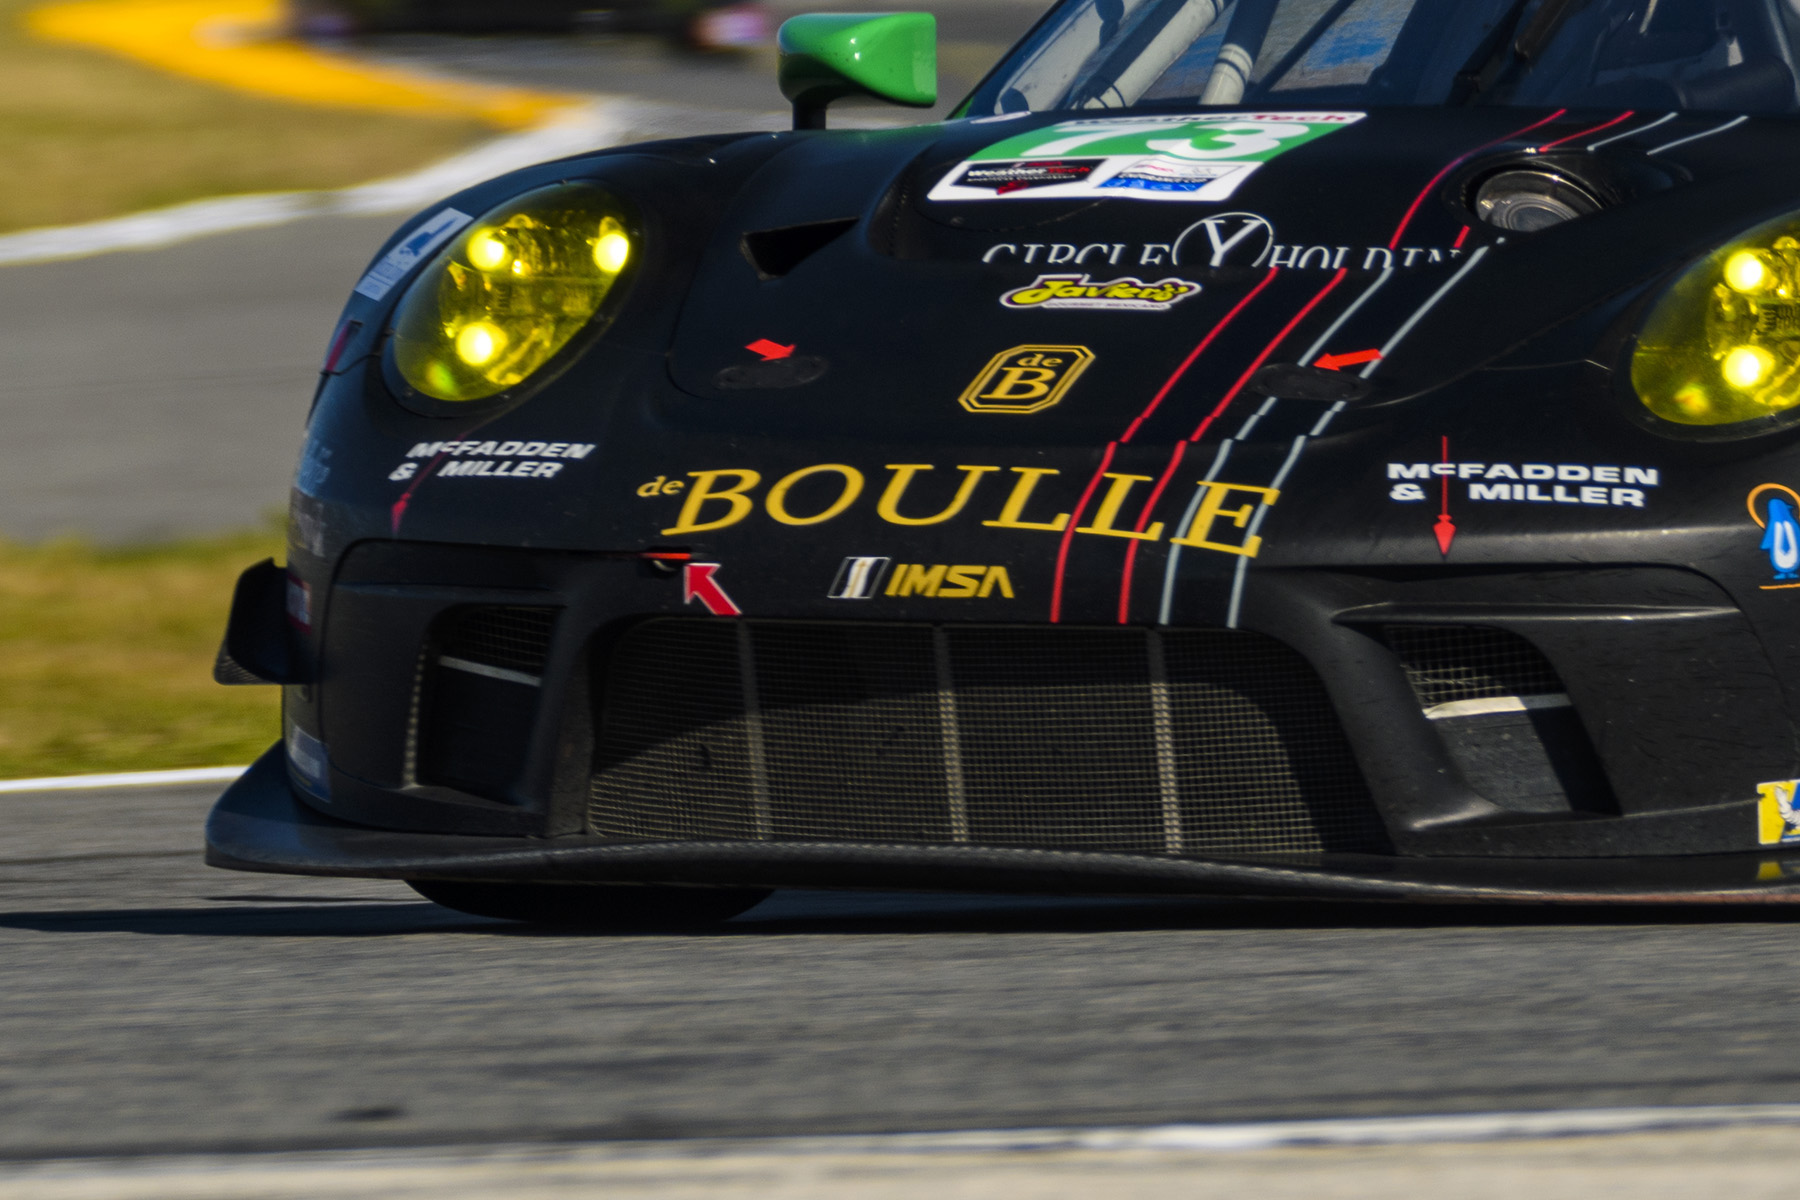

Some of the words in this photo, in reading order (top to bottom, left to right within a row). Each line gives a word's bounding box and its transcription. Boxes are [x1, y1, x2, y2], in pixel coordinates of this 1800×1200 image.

[1020, 122, 1310, 159] 73
[1016, 353, 1064, 367] de
[979, 366, 1056, 400] B
[388, 463, 418, 480] &
[437, 461, 564, 478] MILLER
[661, 464, 1281, 558] BOULLE
[1389, 483, 1427, 501] &
[1468, 483, 1646, 508] MILLER
[885, 563, 1015, 598] IMSA
